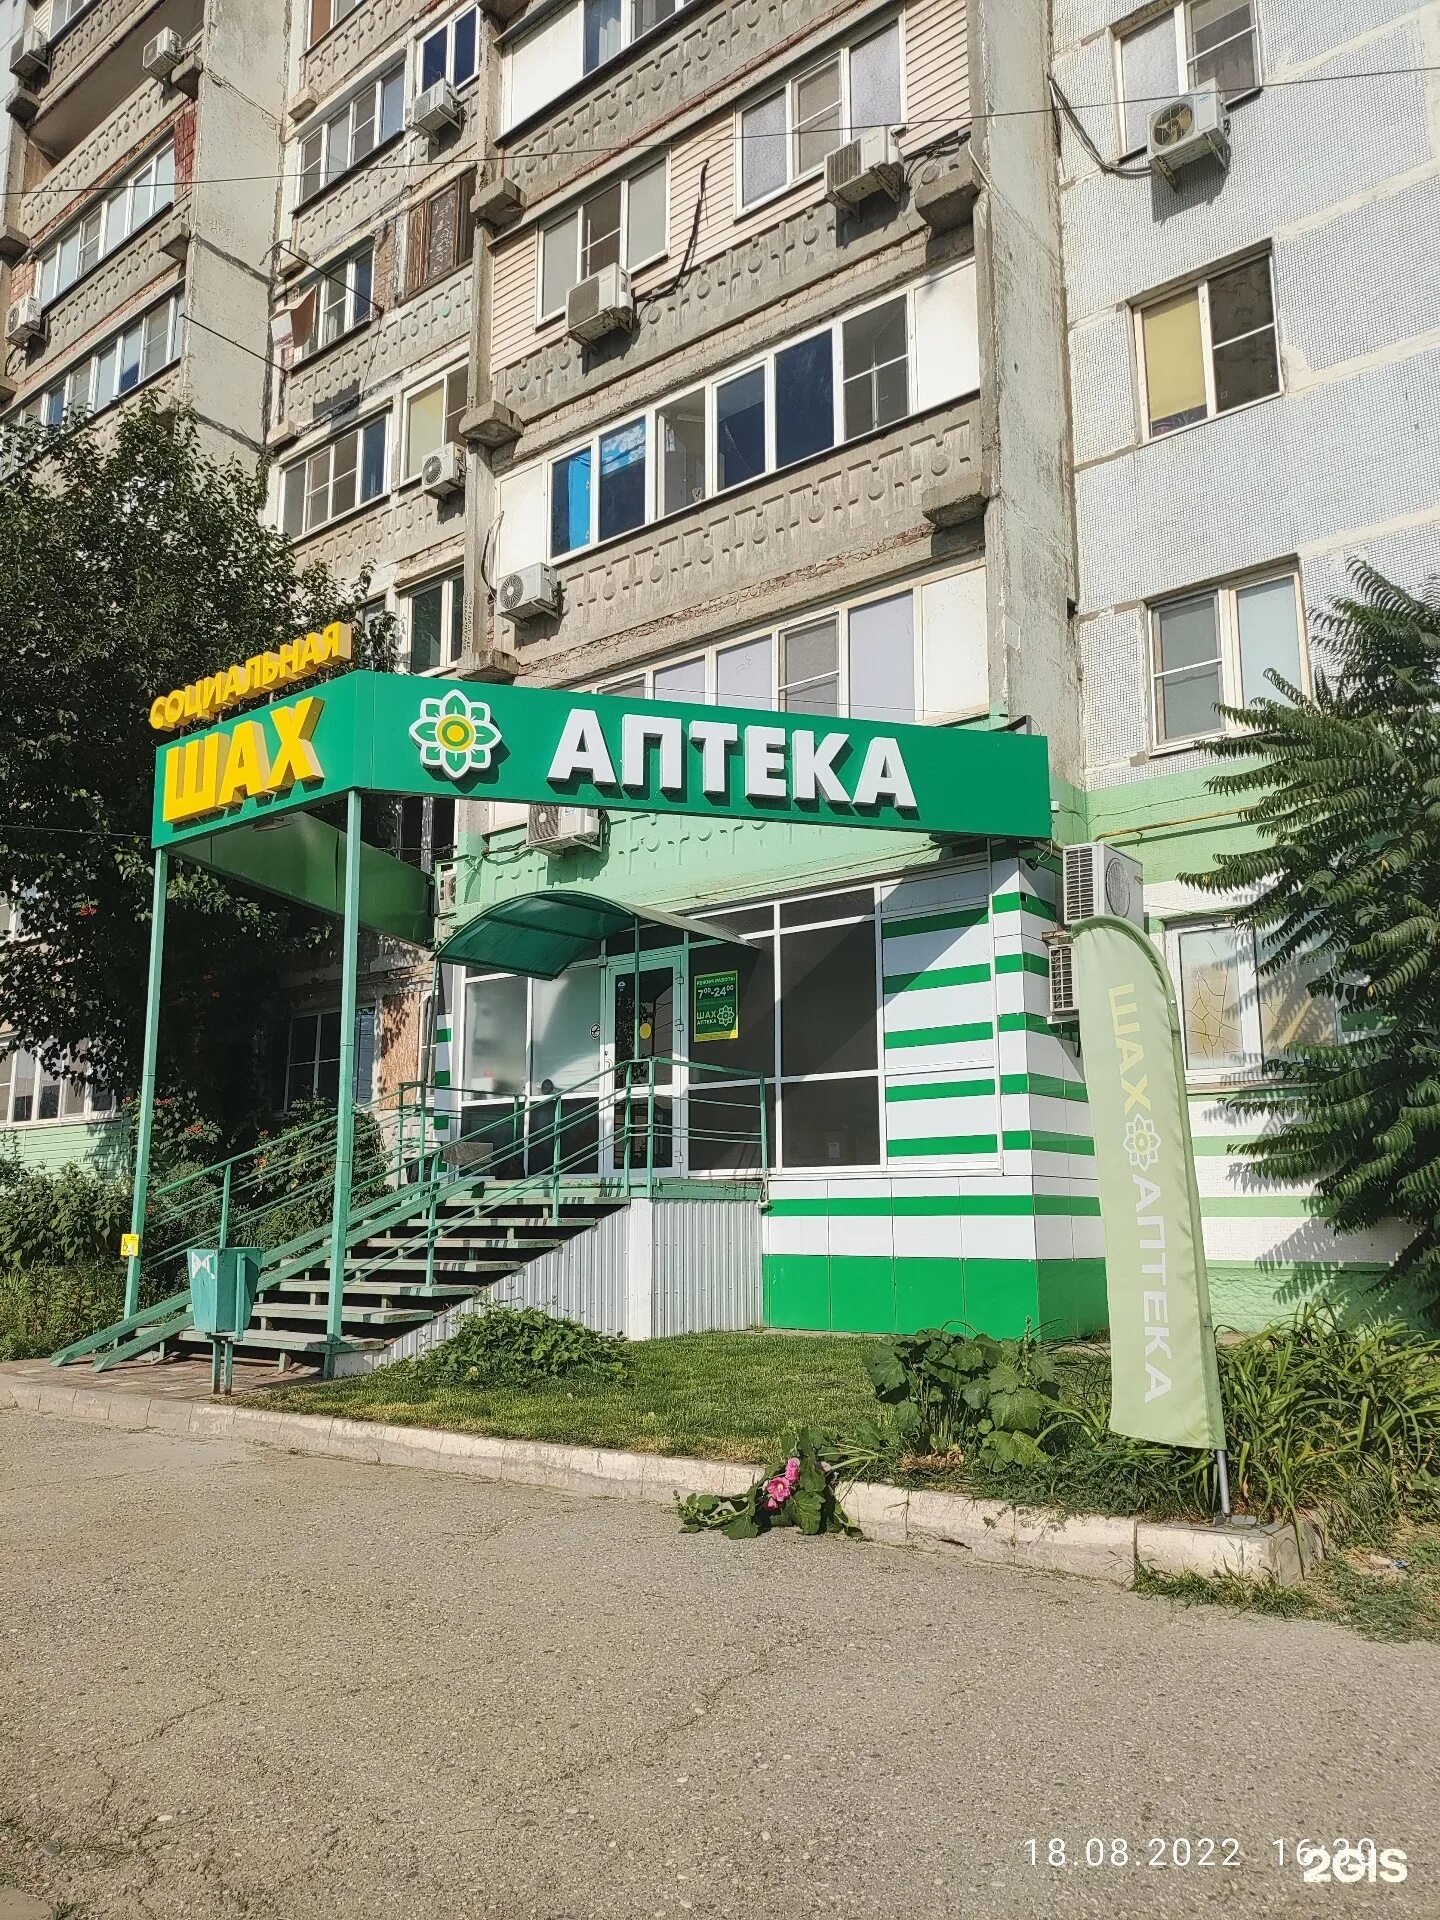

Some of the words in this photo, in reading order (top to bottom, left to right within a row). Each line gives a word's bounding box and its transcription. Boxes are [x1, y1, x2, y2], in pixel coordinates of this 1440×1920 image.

[149, 621, 353, 732] СОЦИАЛЬНАЯ
[163, 697, 325, 823] ШАХ
[547, 708, 918, 811] АПТЕКА
[696, 1010, 717, 1020] ШАХ
[1108, 983, 1151, 1115] ШАХ
[1132, 1174, 1172, 1404] АПТЕКА
